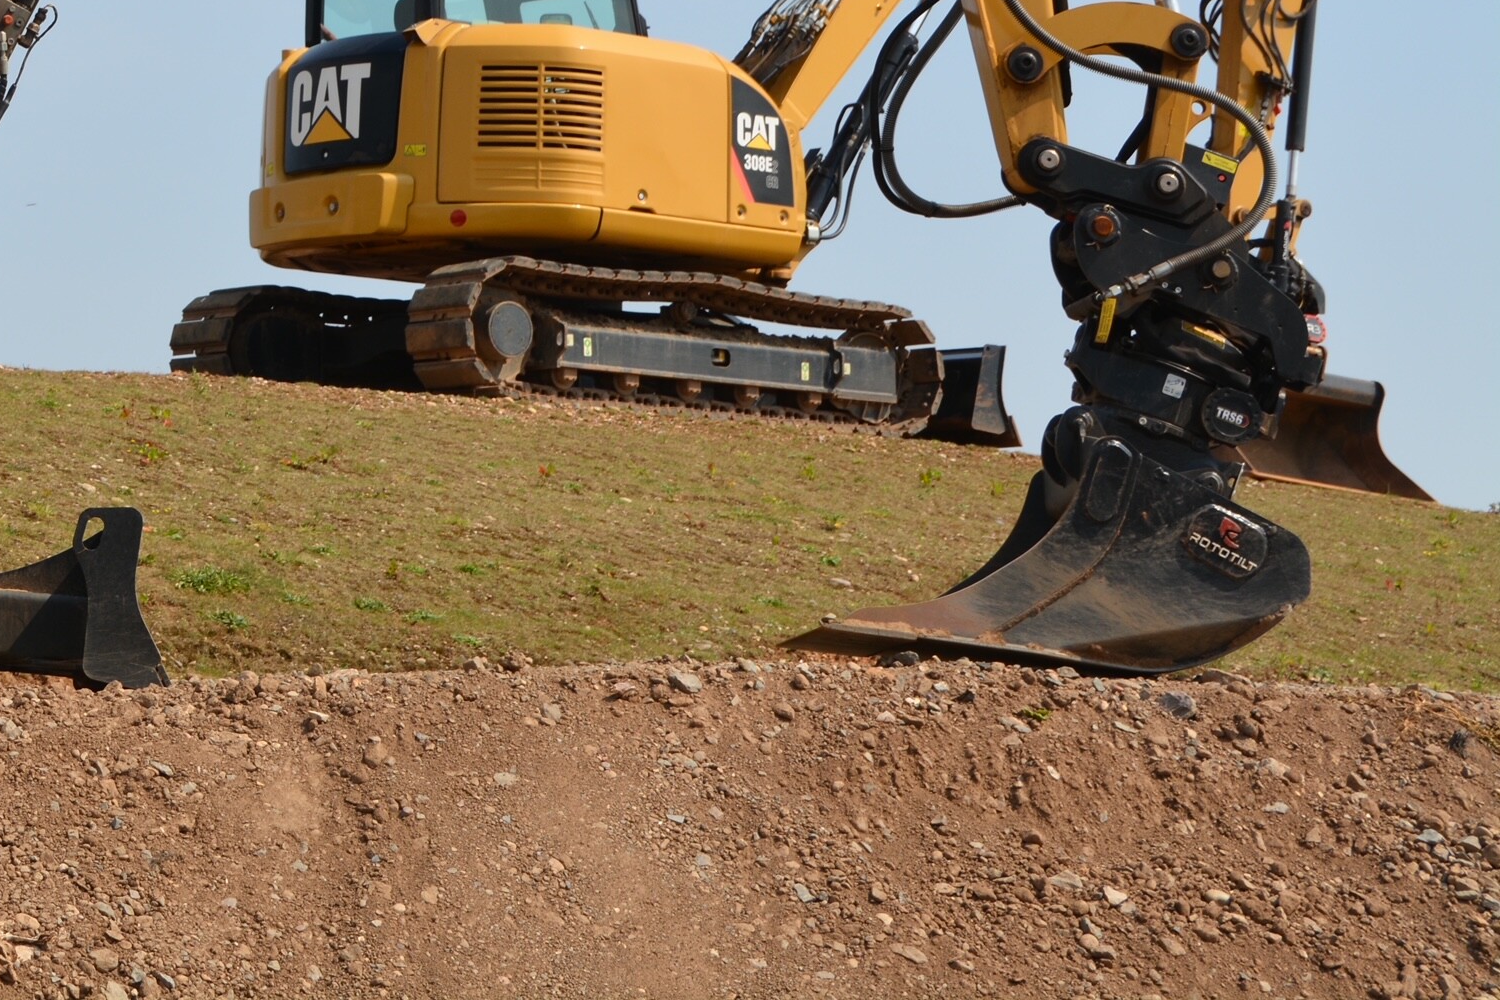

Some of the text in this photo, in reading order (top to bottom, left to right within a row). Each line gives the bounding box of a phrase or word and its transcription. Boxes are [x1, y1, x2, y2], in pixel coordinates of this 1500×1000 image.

[290, 62, 371, 147] CAT
[737, 112, 779, 151] CAT
[1216, 406, 1244, 425] TRS6
[1189, 532, 1258, 571] ROTOTILT
